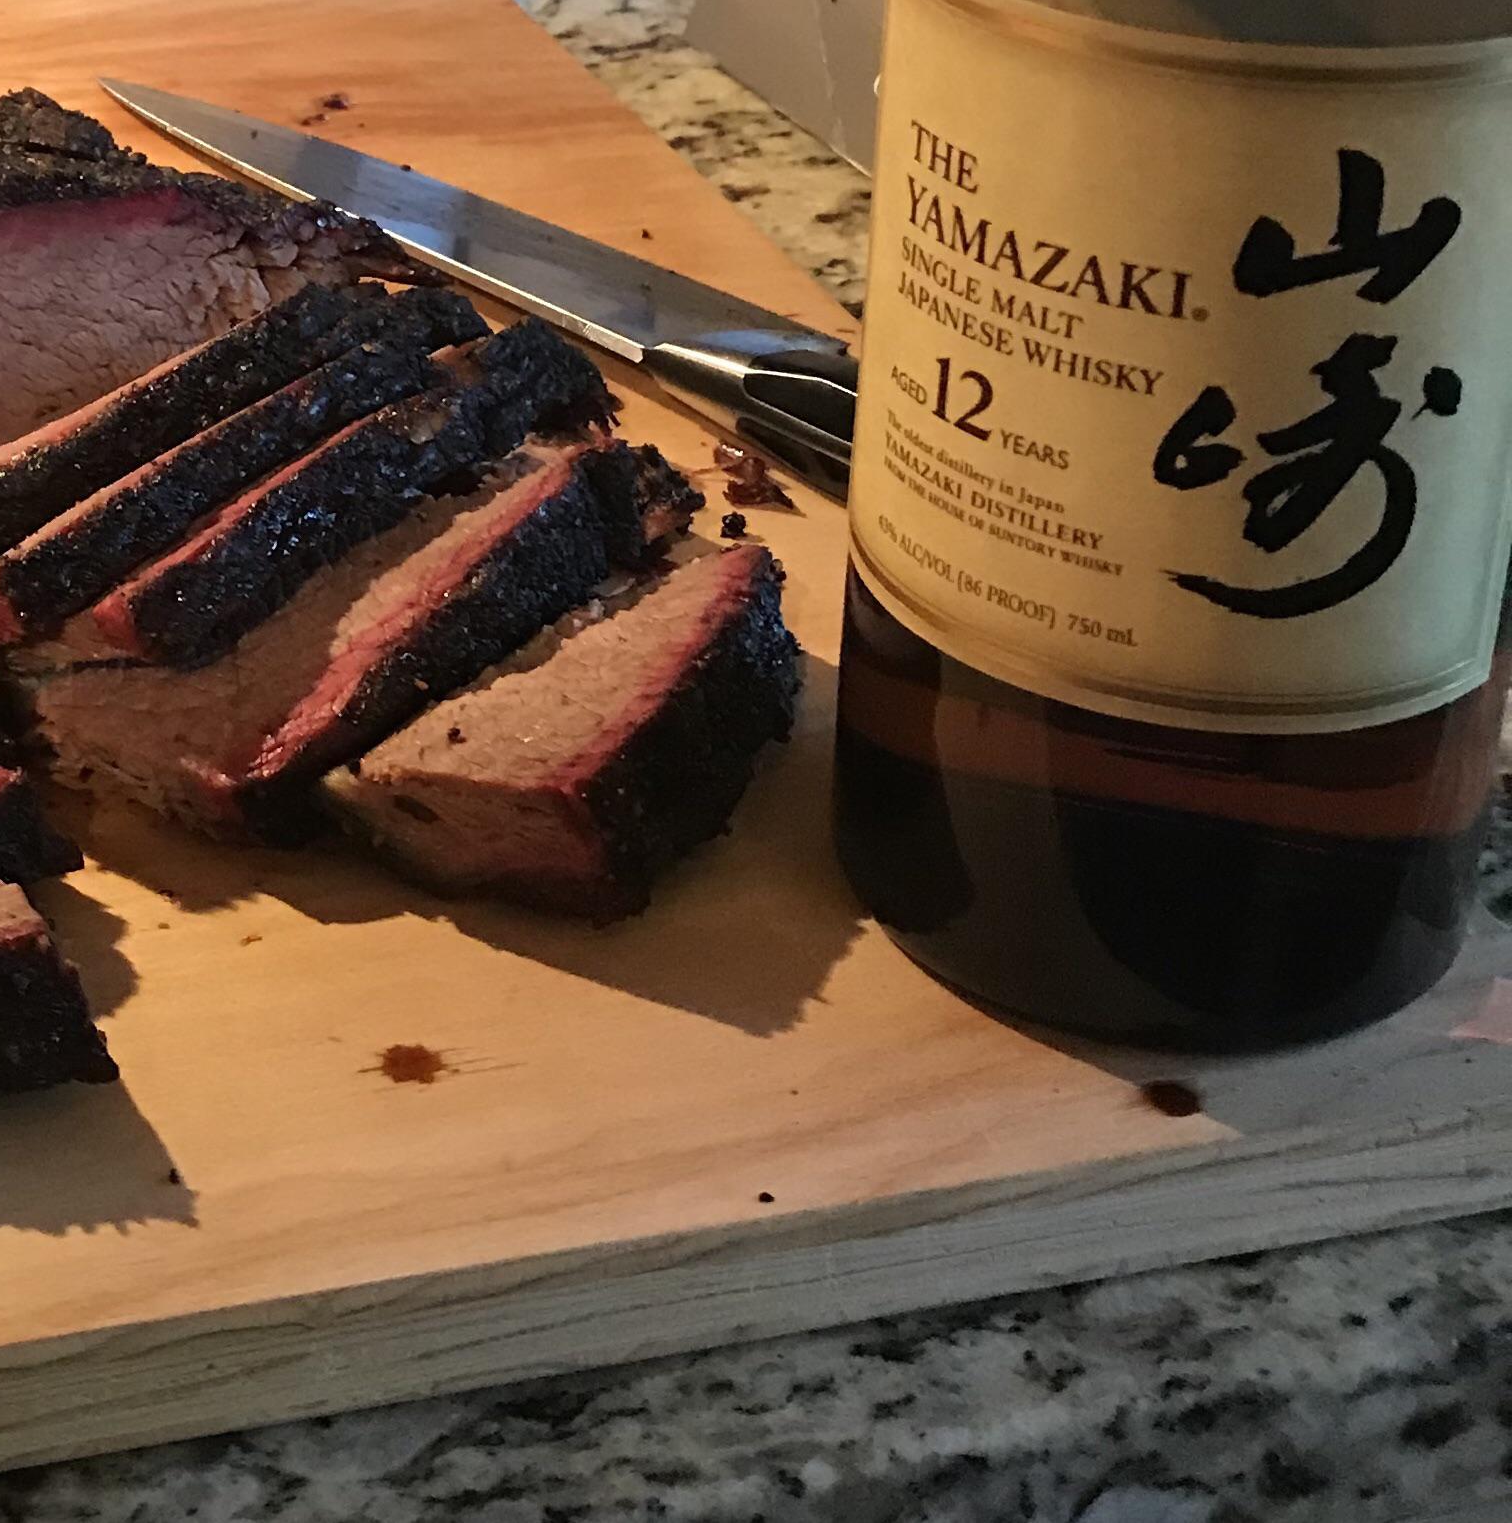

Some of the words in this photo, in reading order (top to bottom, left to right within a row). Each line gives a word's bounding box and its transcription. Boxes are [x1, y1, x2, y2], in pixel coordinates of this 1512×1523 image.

[911, 119, 980, 195] THE
[901, 235, 981, 306] SINGLE
[991, 287, 1085, 339] MALT
[898, 271, 1014, 356] JAPANESE
[1022, 336, 1165, 396] WHISKY
[891, 365, 928, 405] AGED
[932, 357, 994, 441] 12
[1001, 429, 1070, 470] YEARS
[885, 430, 962, 499] YAMAZAKI
[971, 490, 1103, 550] DISTILLERY
[936, 448, 994, 490] distillery
[999, 478, 1014, 496] in
[1018, 487, 1065, 514] Japan
[968, 514, 984, 531] OF
[989, 521, 1055, 558] SUNTORY
[1059, 550, 1124, 576] WHISKY
[1067, 613, 1103, 638] 750
